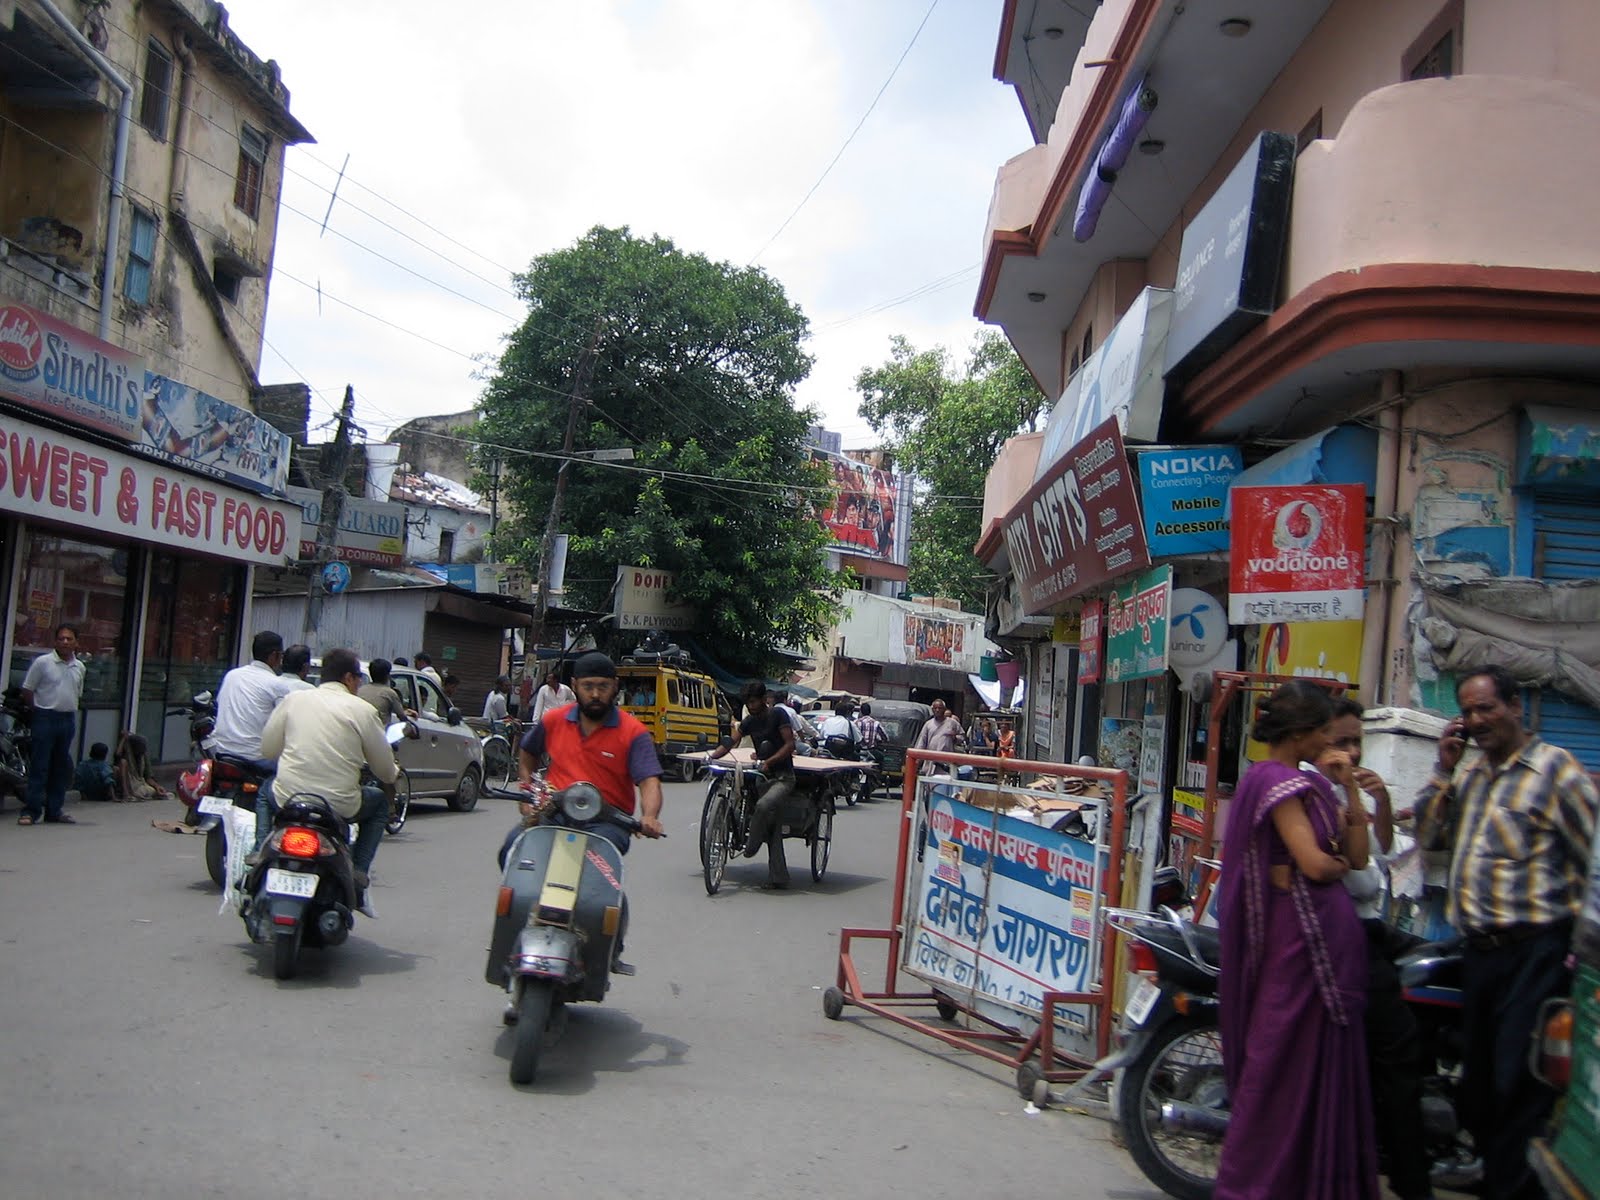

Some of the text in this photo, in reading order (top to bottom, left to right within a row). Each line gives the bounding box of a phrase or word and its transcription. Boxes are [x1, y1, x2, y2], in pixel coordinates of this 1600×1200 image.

[44, 331, 138, 419] Sindhi's
[172, 455, 226, 478] SWEETS
[1150, 454, 1235, 476] NOKIA
[1150, 472, 1231, 488] Connecting Peopl
[117, 467, 139, 525] &
[152, 477, 217, 541] FAST
[222, 497, 286, 555] FOOD
[1171, 497, 1221, 511] Mobile
[339, 509, 400, 536] GUARD
[1006, 468, 1088, 584] CITY GIFTS
[1154, 518, 1231, 536] Accessori
[346, 550, 396, 565] COMPANY
[1247, 553, 1349, 573] vodafone
[1332, 596, 1343, 616] है
[991, 903, 1090, 993] जागरण
[915, 932, 949, 975] विश्व
[953, 958, 975, 988] का
[1005, 985, 1013, 1001] 1
